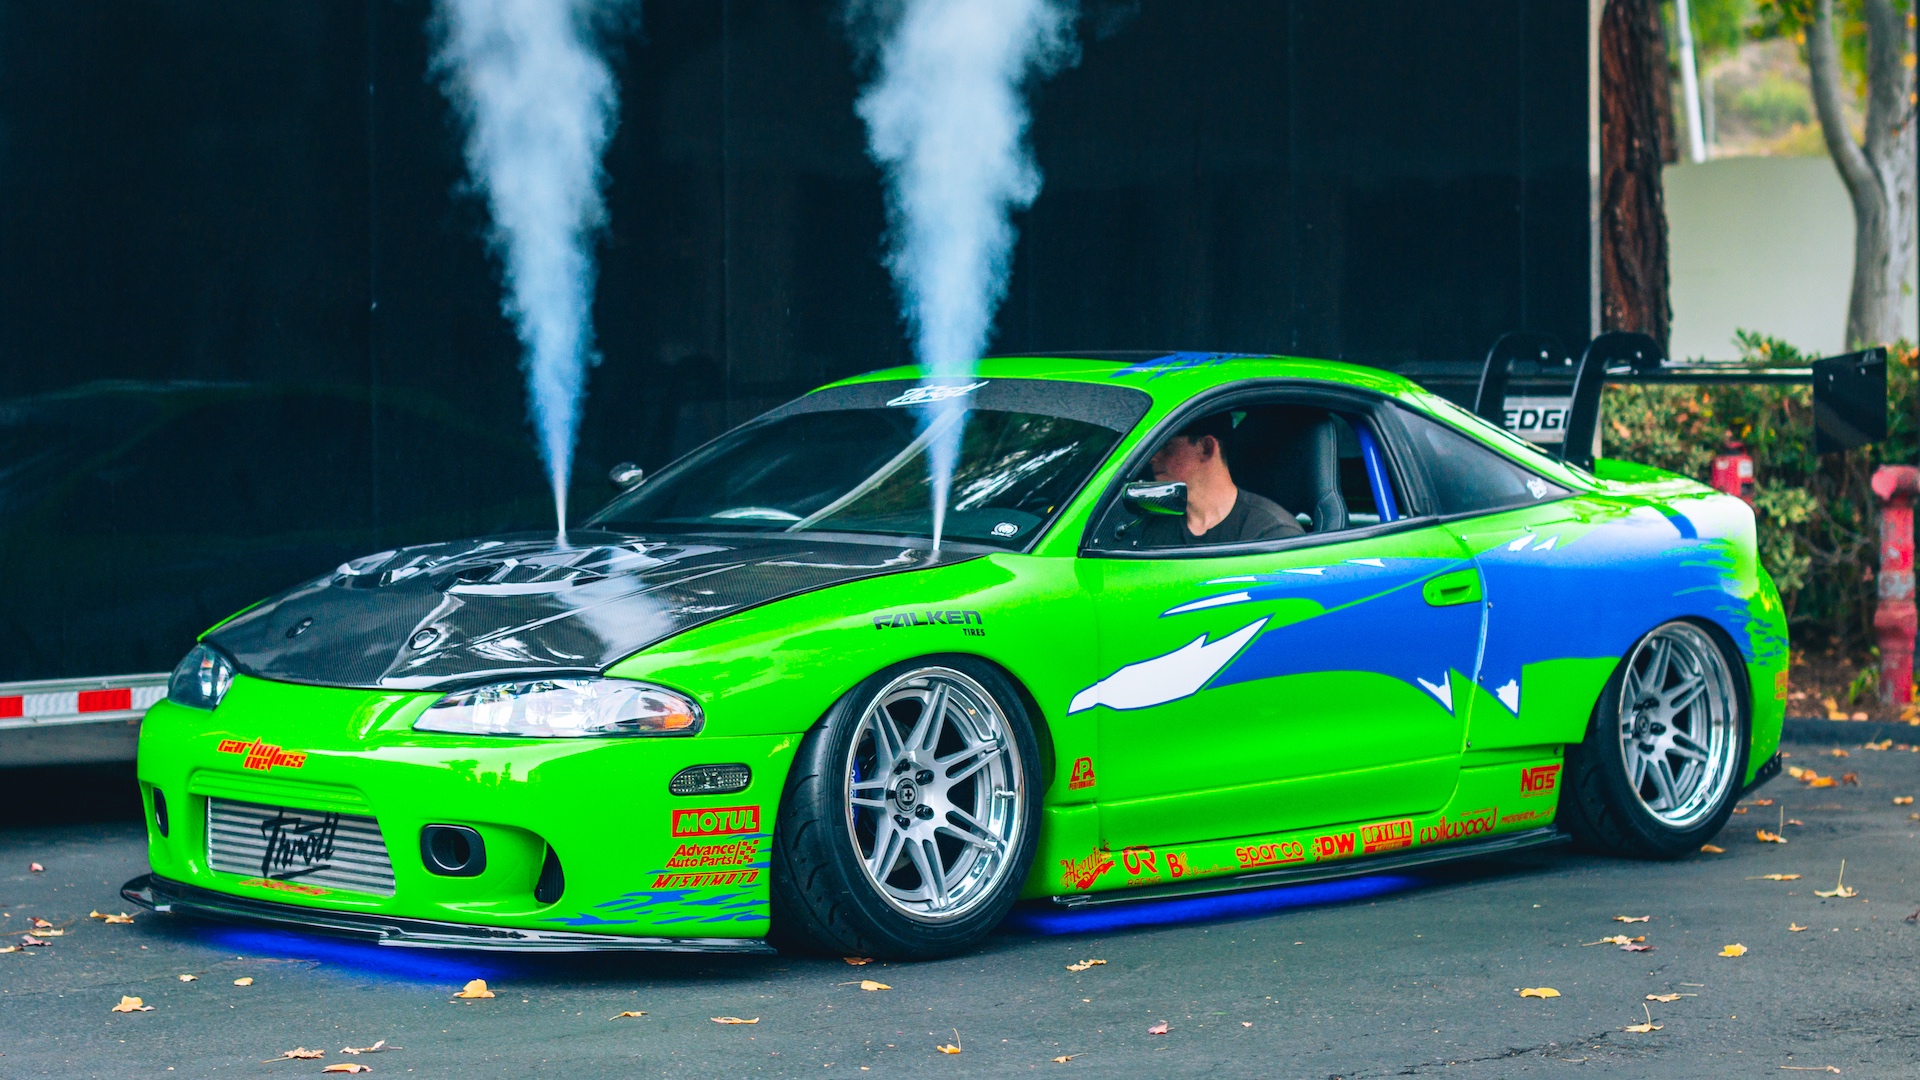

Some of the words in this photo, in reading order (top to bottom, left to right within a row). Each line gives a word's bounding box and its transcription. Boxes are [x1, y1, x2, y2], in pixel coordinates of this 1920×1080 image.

[873, 610, 983, 630] FALKEN
[962, 628, 986, 637] TIRES
[1520, 763, 1561, 792] NOS
[676, 810, 756, 833] MOTUL
[1420, 806, 1498, 844] wilwood
[1362, 821, 1411, 844] OPTIMA
[674, 843, 736, 857] Advance
[1235, 841, 1305, 868] sparco
[666, 857, 698, 868] Auto
[700, 856, 731, 867] Parts
[651, 872, 759, 889] MISHIMOTO
